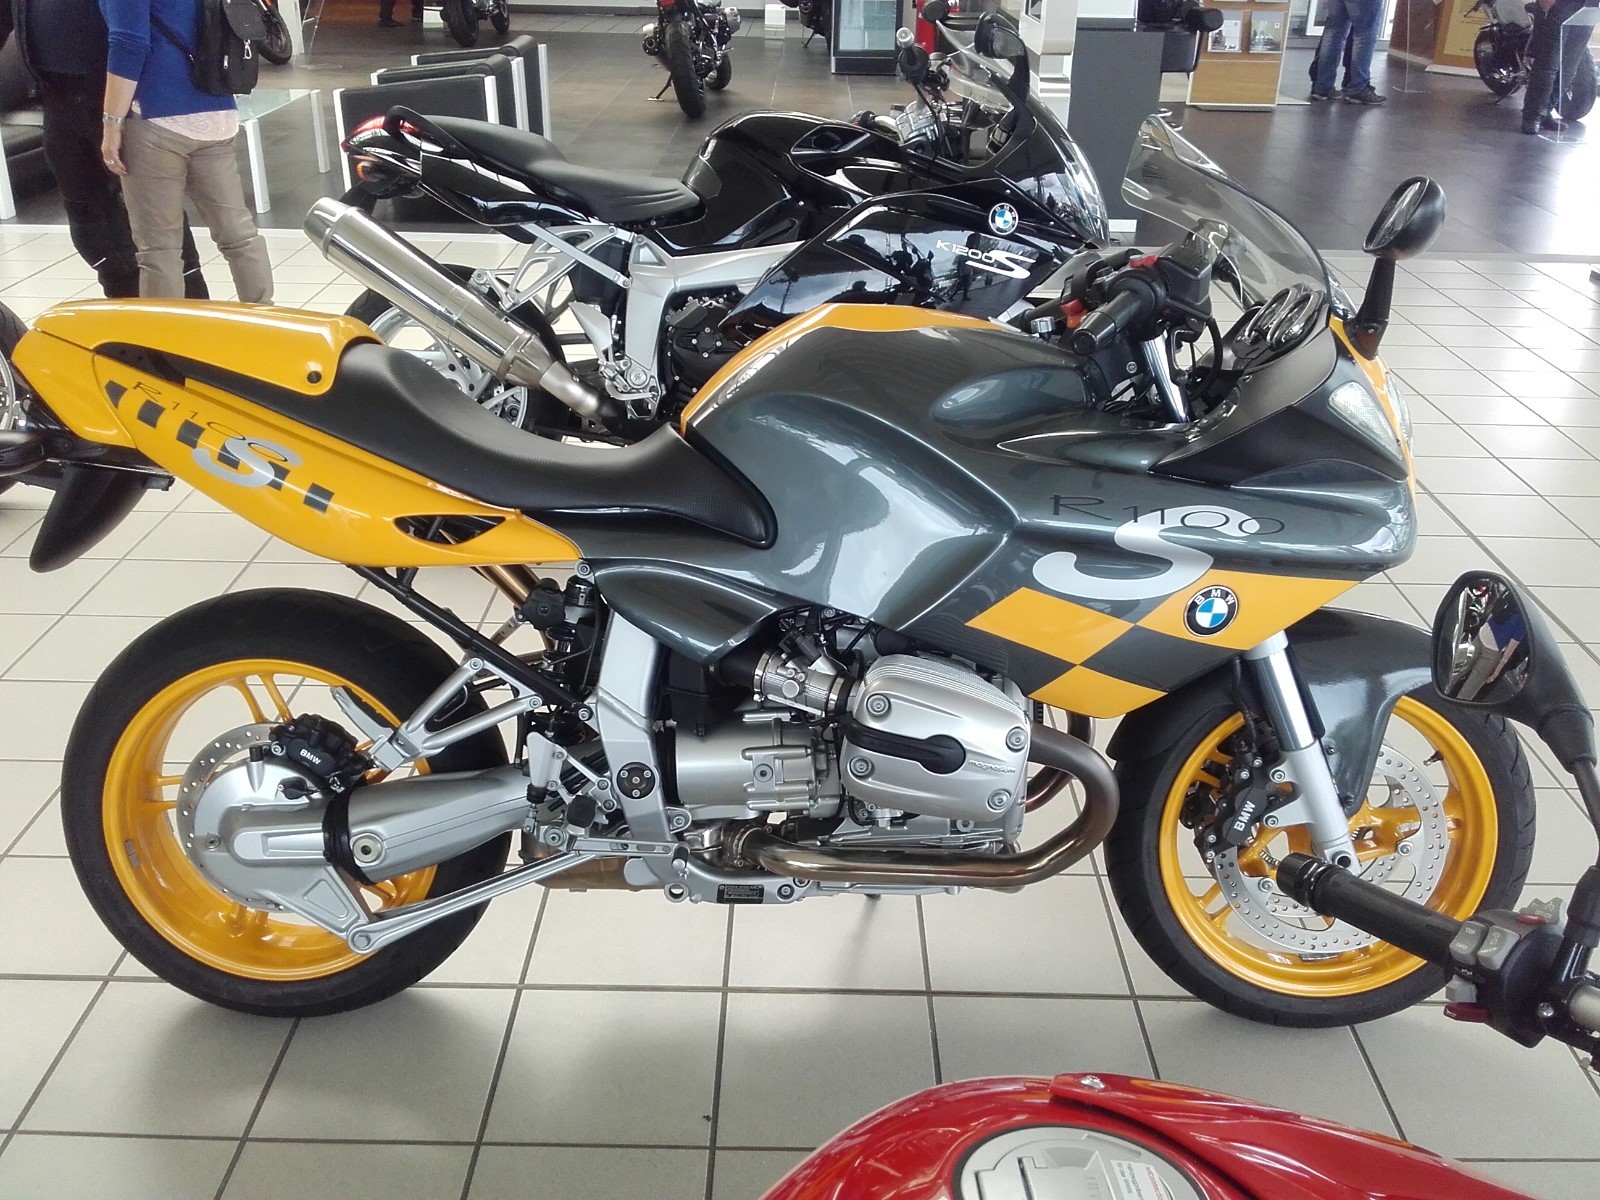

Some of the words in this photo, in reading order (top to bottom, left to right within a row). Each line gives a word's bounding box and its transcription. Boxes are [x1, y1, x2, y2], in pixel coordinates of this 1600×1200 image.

[132, 381, 162, 402] R
[191, 436, 304, 488] S
[1050, 494, 1112, 521] R
[1123, 505, 1286, 536] 1100
[1032, 504, 1261, 601] S
[300, 748, 321, 764] BMW
[1233, 800, 1256, 832] BMW
